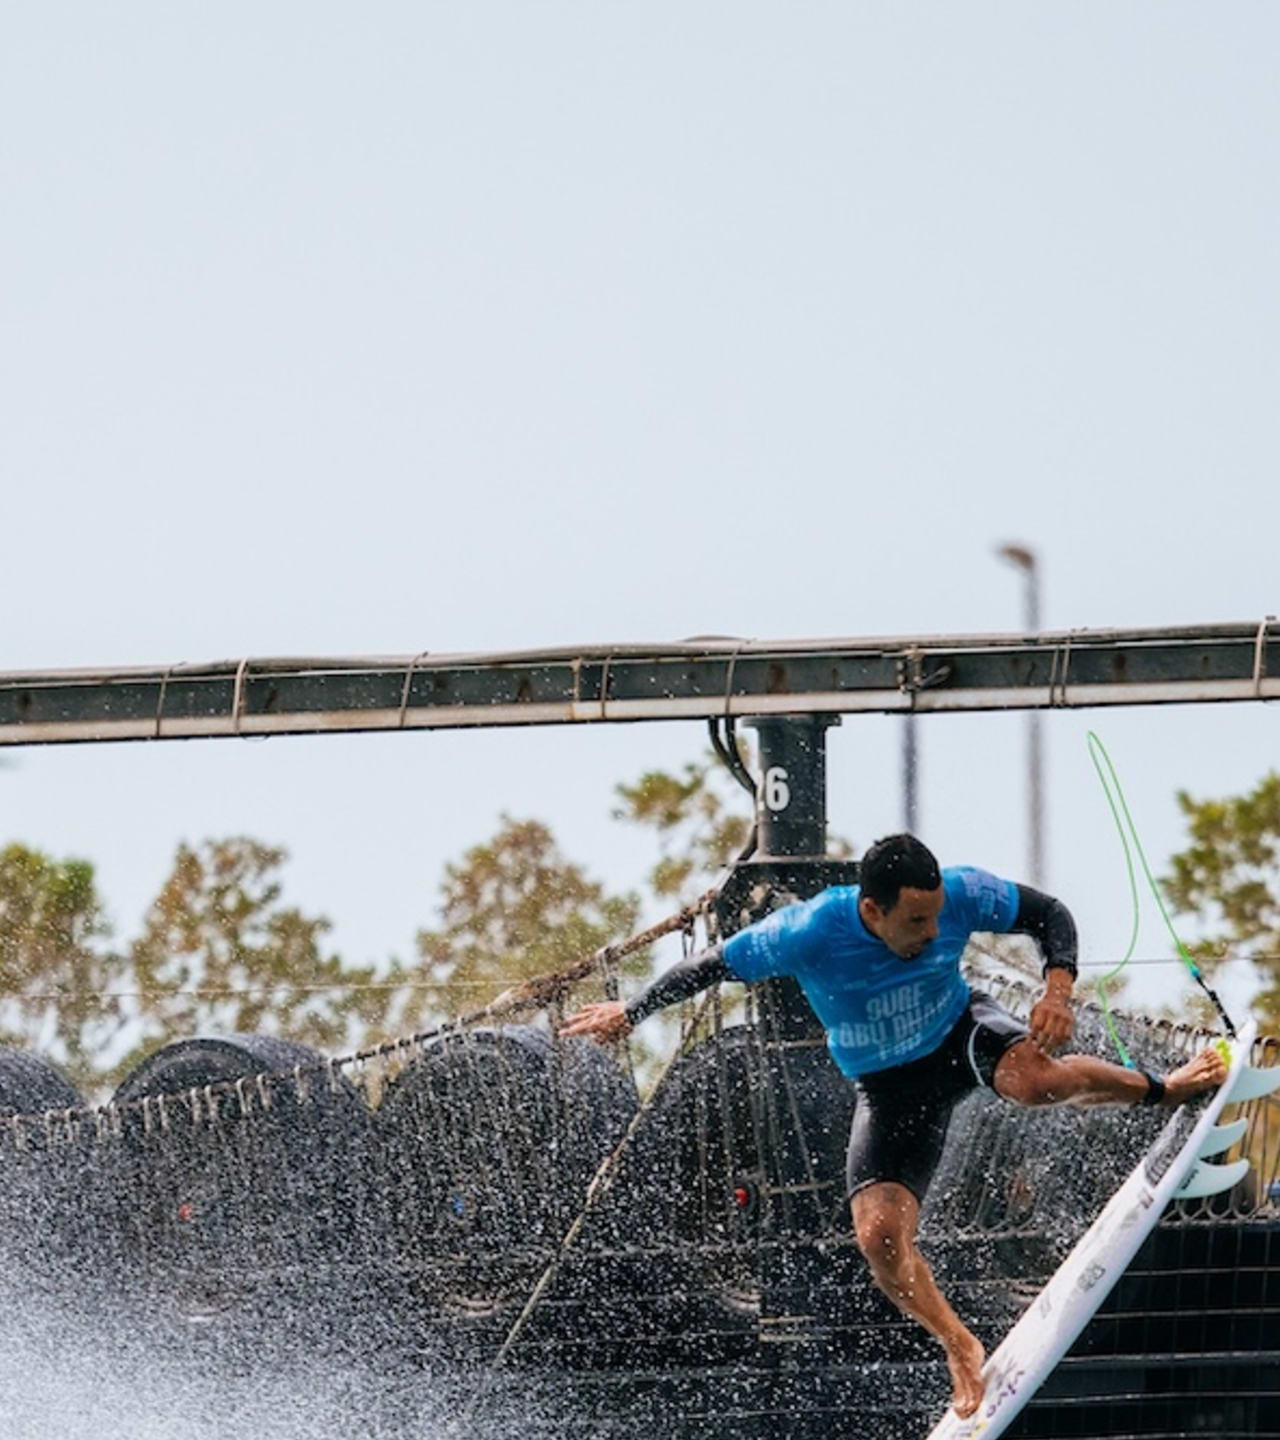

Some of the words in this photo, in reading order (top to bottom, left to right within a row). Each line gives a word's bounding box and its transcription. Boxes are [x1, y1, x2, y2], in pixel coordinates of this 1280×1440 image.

[839, 1021, 886, 1049] ABU
[892, 989, 953, 1044] DHA
[865, 981, 925, 1022] SURF
